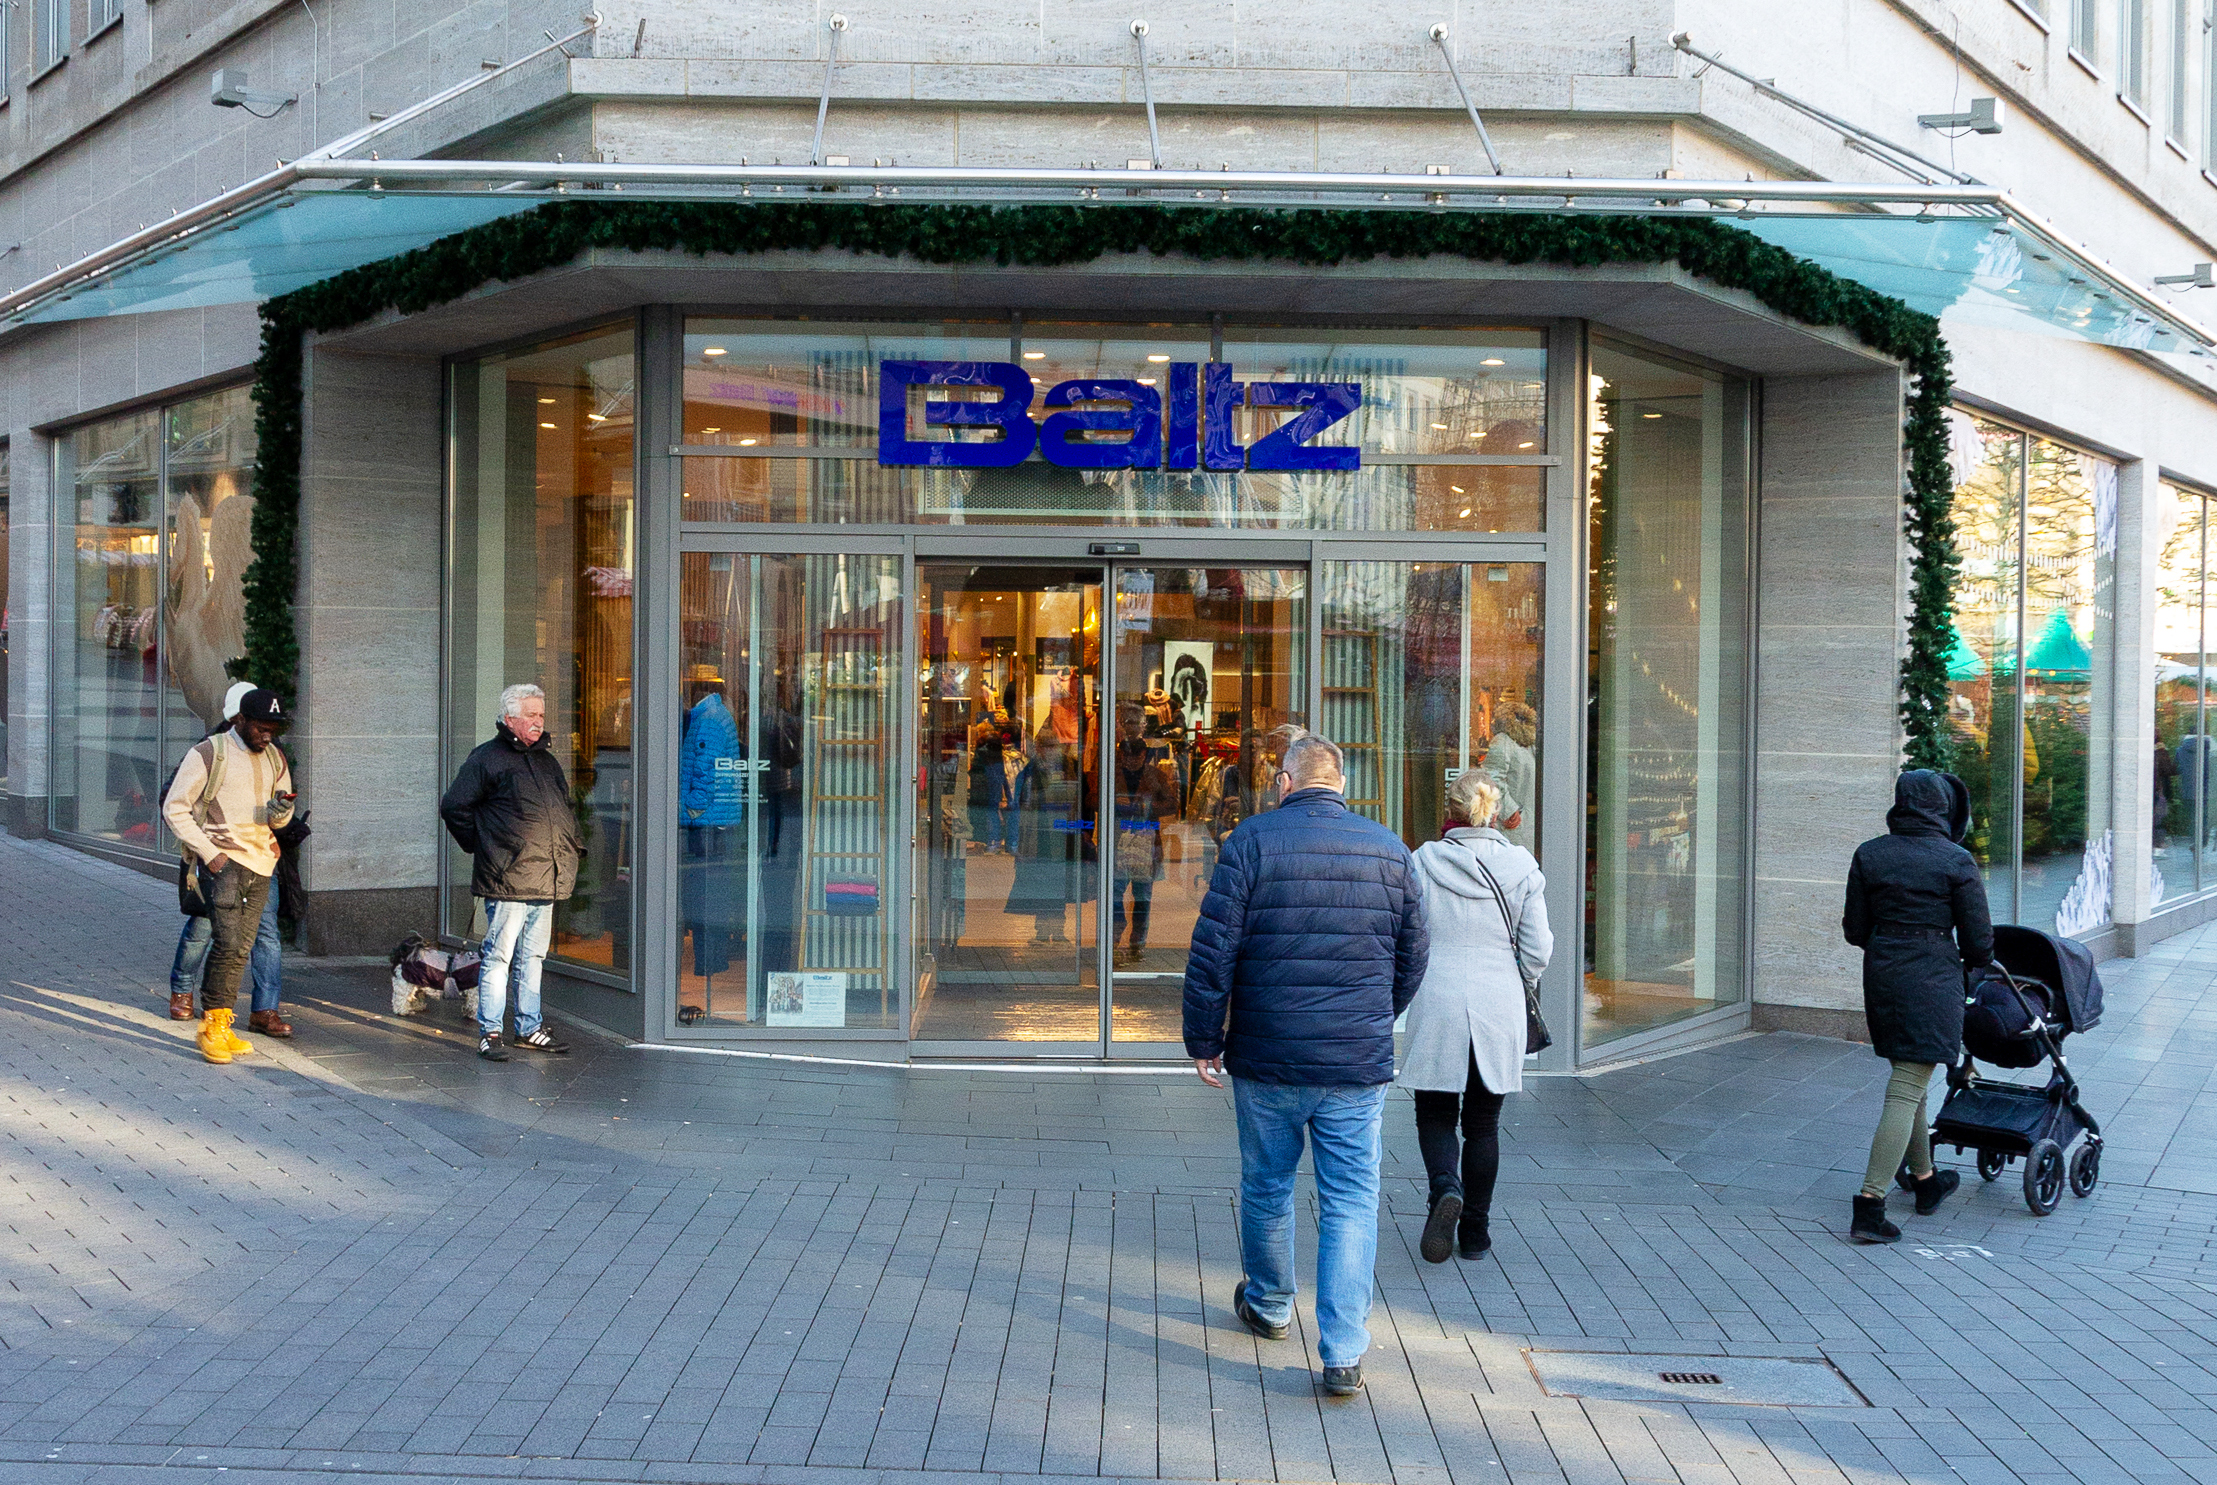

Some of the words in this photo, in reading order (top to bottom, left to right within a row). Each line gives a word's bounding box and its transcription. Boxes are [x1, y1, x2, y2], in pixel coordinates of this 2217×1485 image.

[879, 360, 1361, 469] Baltz
[269, 698, 280, 713] A
[715, 758, 770, 770] Balz
[1053, 819, 1095, 829] Baltz
[1120, 820, 1160, 830] Baltz
